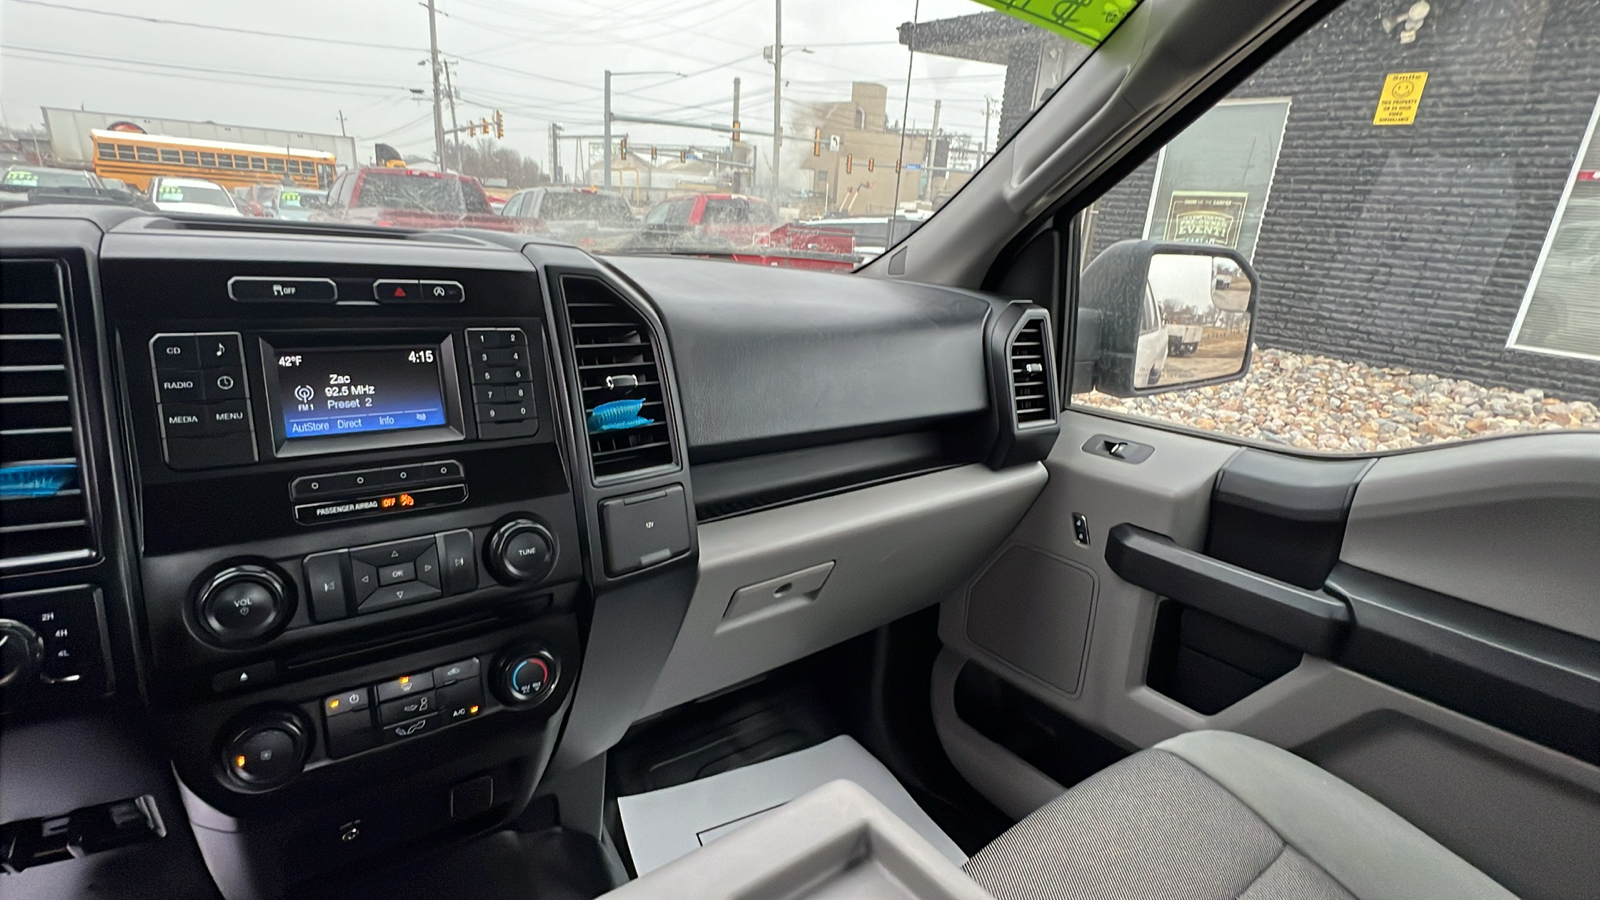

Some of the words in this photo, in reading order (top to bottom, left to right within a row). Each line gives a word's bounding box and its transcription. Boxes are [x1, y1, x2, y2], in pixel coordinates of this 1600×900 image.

[1178, 224, 1227, 237] EVENT!
[510, 334, 516, 342] 2
[166, 346, 181, 355] CD
[408, 350, 434, 363] 4:15
[482, 353, 487, 361] 3
[513, 352, 519, 360] 4
[484, 372, 490, 380] 5
[515, 370, 521, 378] 6
[329, 374, 351, 385] Zac
[163, 381, 194, 389] RADIO
[324, 386, 349, 397] 92.5
[351, 385, 375, 396] MHz
[488, 391, 493, 399] 7
[518, 388, 524, 397] 8
[327, 400, 360, 410] Preset
[364, 398, 372, 407] 2
[489, 409, 495, 417] 9
[520, 407, 526, 415] 0
[168, 415, 198, 424] MEDIA
[216, 412, 243, 420] MENU
[379, 415, 394, 425] Info
[292, 421, 330, 433] AutStore
[337, 418, 362, 429] Direct
[316, 504, 355, 516] PASSENGER
[355, 501, 378, 511] AIRBAG
[382, 498, 396, 507] OFF
[518, 547, 536, 556] TUNE
[391, 569, 404, 578] OK
[233, 599, 253, 608] VOL
[41, 612, 54, 621] 2H
[55, 629, 68, 637] 4H
[453, 708, 466, 717] A/C
